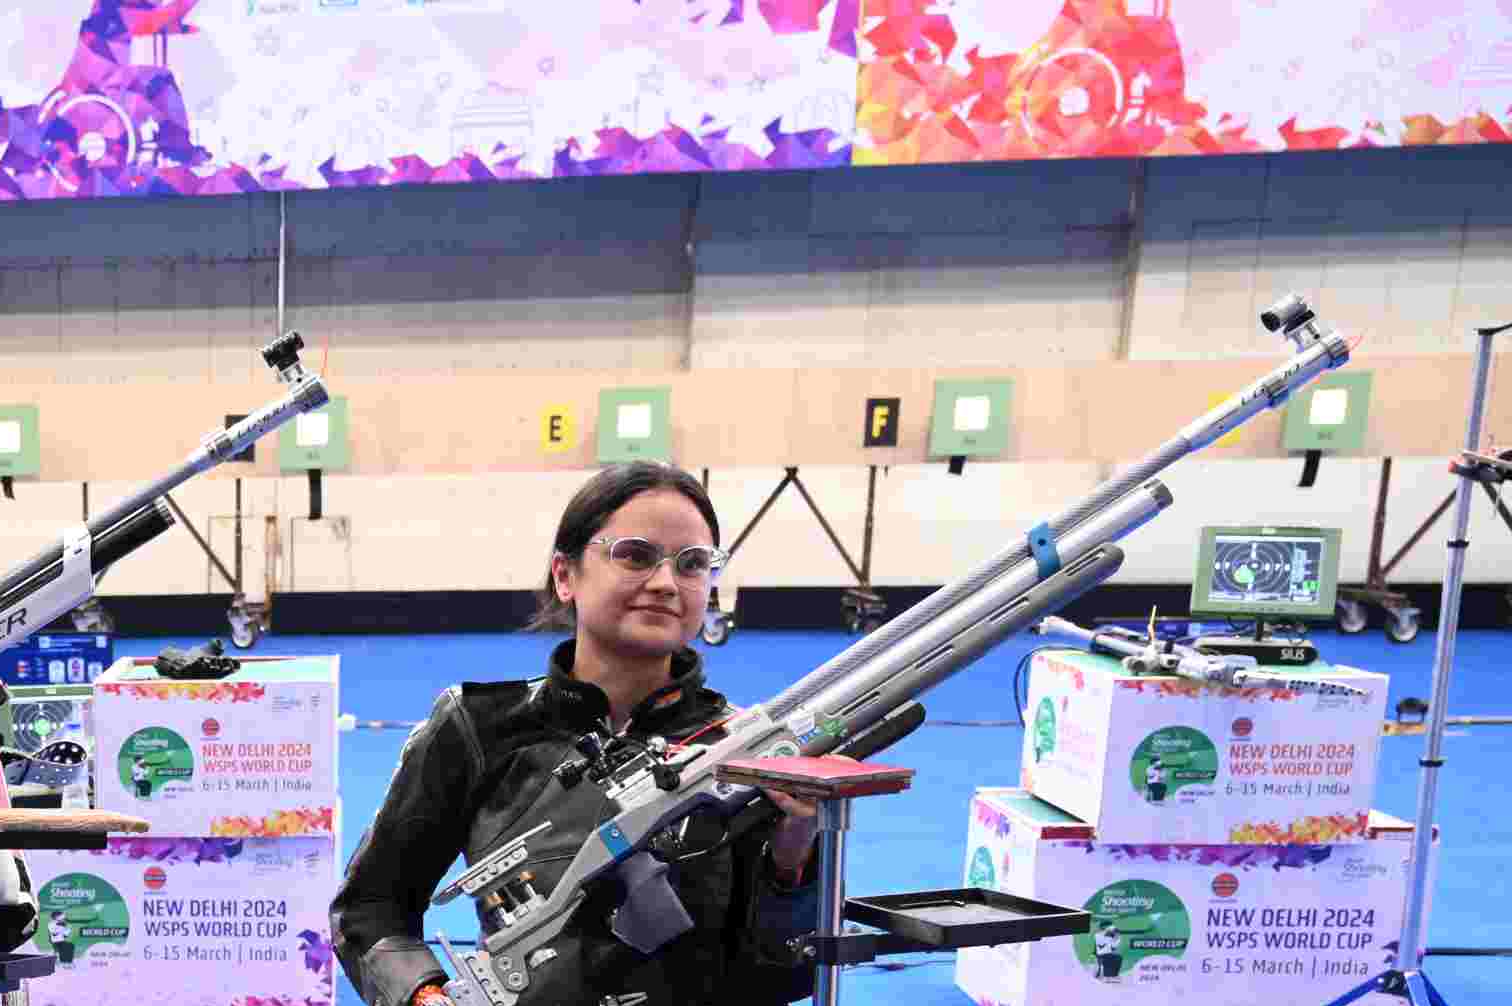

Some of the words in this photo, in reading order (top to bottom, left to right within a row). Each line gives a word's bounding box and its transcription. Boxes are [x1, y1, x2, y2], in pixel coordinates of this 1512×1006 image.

[549, 415, 562, 441] E
[872, 406, 889, 437] F
[202, 743, 233, 757] NEW
[238, 743, 274, 757] DELHI
[279, 743, 311, 757] 2024
[1229, 744, 1264, 759] NEW
[1270, 744, 1311, 759] DELHI
[1316, 744, 1354, 758] 2024
[203, 760, 236, 773] WSPS
[242, 760, 284, 773] WORLD
[288, 760, 312, 773] CUP
[1229, 762, 1267, 776] WSPS
[1272, 762, 1321, 776] WORLD
[1326, 762, 1353, 776] CUP
[202, 779, 230, 791] 6-15
[235, 779, 269, 791] March
[282, 779, 312, 791] India
[1225, 783, 1257, 795] 6-15
[1264, 783, 1303, 795] March
[1317, 782, 1350, 795] India
[50, 887, 95, 901] Shooting
[143, 900, 183, 918] NEW
[189, 900, 238, 918] DELHI
[243, 900, 287, 918] 2024
[1102, 896, 1154, 911] Shooting
[1207, 908, 1255, 928] NEW
[1261, 908, 1317, 928] DELHI
[1323, 908, 1375, 928] 2024
[144, 921, 189, 938] WSPS
[194, 921, 252, 938] WORLD
[256, 921, 288, 938] CUP
[1207, 932, 1258, 949] WSPS
[1264, 932, 1330, 949] WORLD
[1336, 932, 1373, 949] CUP
[143, 945, 181, 961] 6-15
[187, 945, 232, 961] March
[248, 945, 288, 961] India
[1201, 958, 1245, 973] 6-15
[1251, 958, 1303, 975] March
[1323, 959, 1369, 976] India
